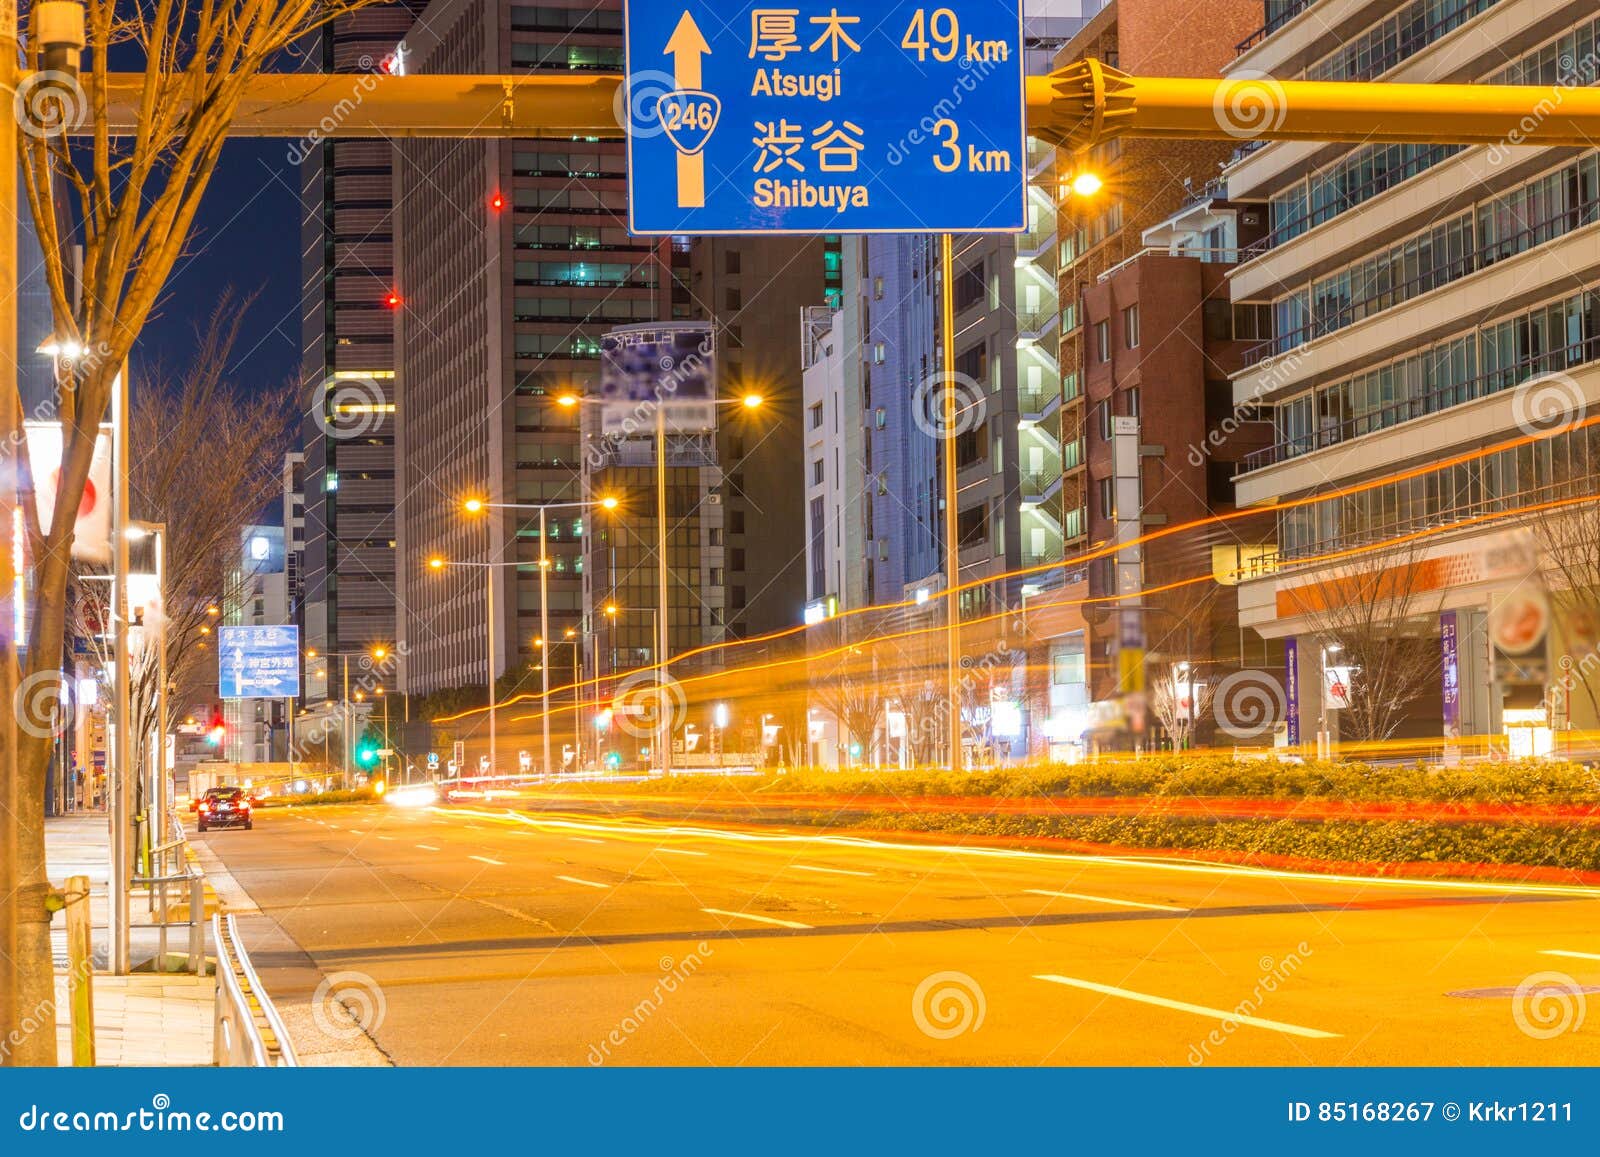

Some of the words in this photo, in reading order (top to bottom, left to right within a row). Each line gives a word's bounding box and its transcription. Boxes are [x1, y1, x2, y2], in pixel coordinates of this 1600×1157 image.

[748, 9, 861, 62] 厚木
[901, 8, 959, 62] 49
[966, 34, 1008, 62] km
[751, 69, 842, 102] Atsugi
[667, 102, 713, 130] 246
[752, 119, 865, 173] 渋谷
[932, 118, 962, 173] 3
[968, 144, 1011, 172] km
[753, 178, 869, 213] Shibuya
